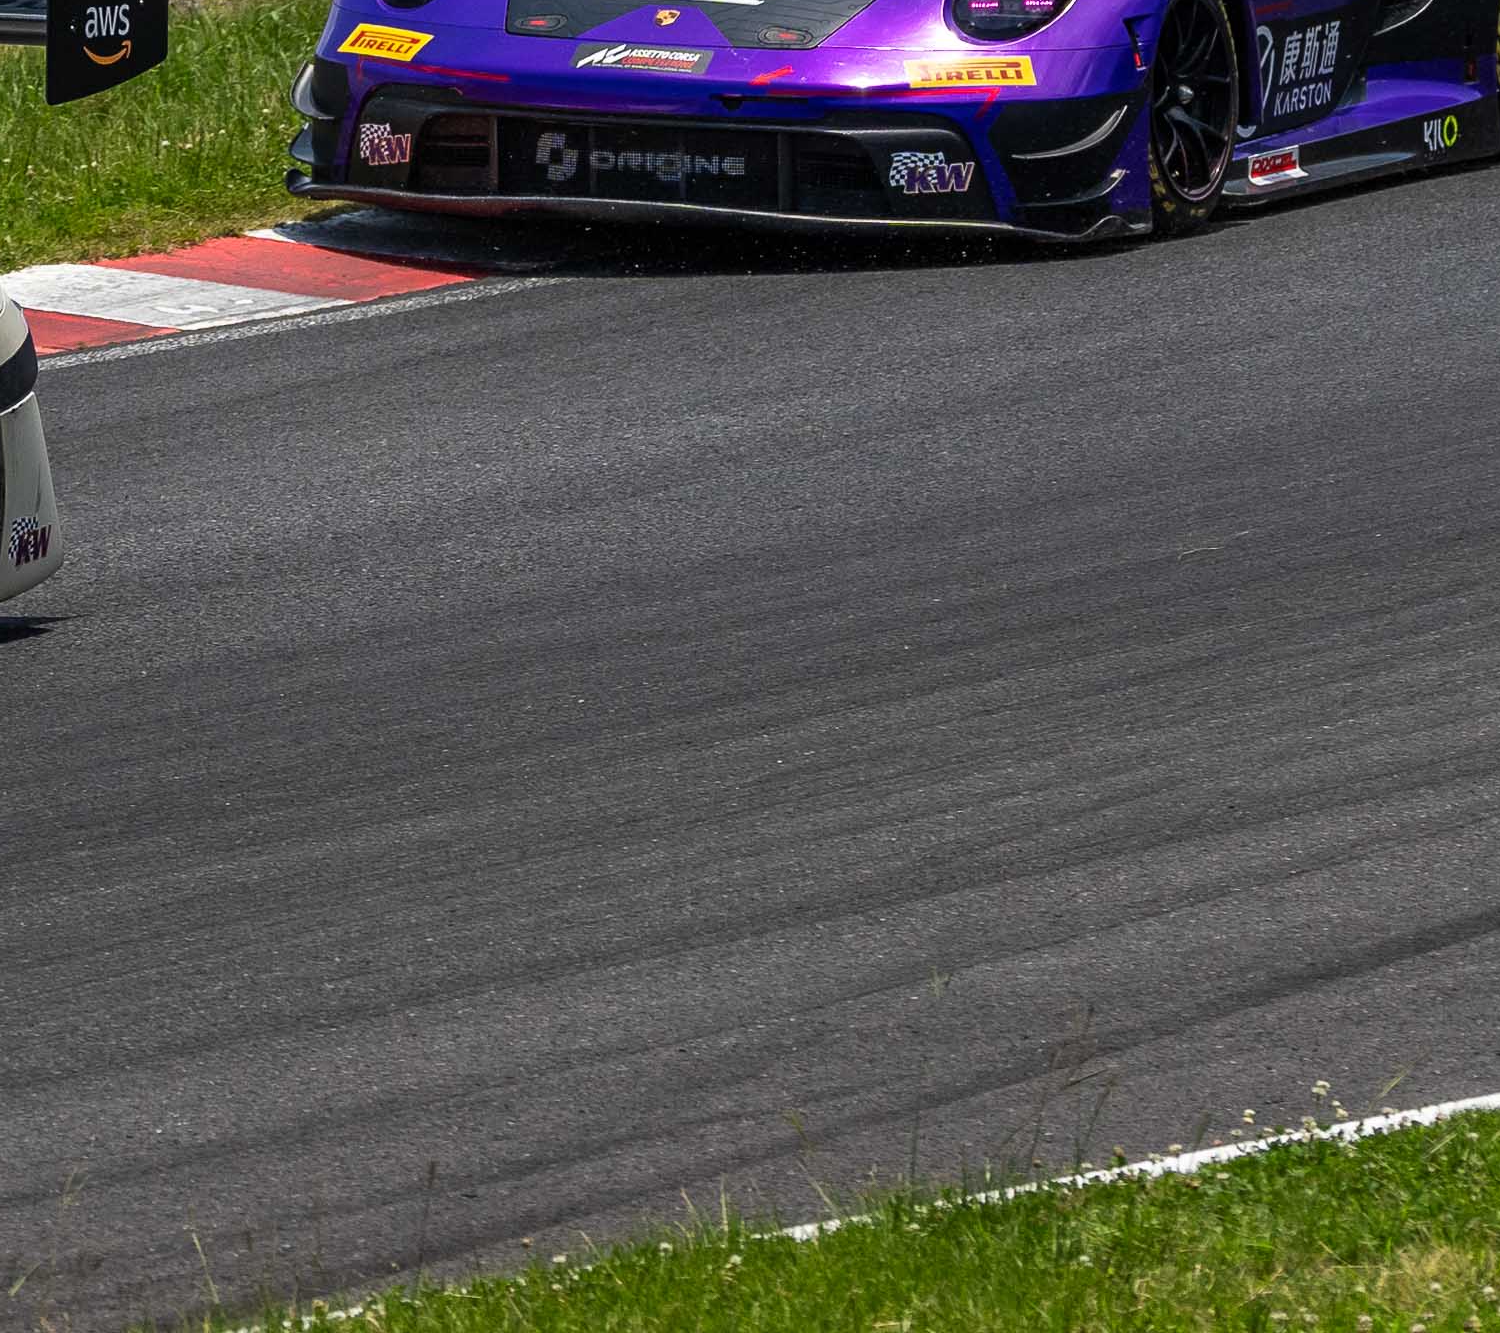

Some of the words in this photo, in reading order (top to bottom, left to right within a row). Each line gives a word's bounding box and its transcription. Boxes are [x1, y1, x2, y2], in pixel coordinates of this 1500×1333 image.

[83, 3, 130, 39] aws
[349, 29, 421, 56] PIRELLI
[629, 49, 669, 60] ASSETTO
[668, 51, 702, 62] CORSA
[1280, 20, 1341, 86] 康斯通
[919, 61, 1024, 82] PIRELLI
[1273, 79, 1334, 117] KARSTON
[903, 161, 976, 195] KW
